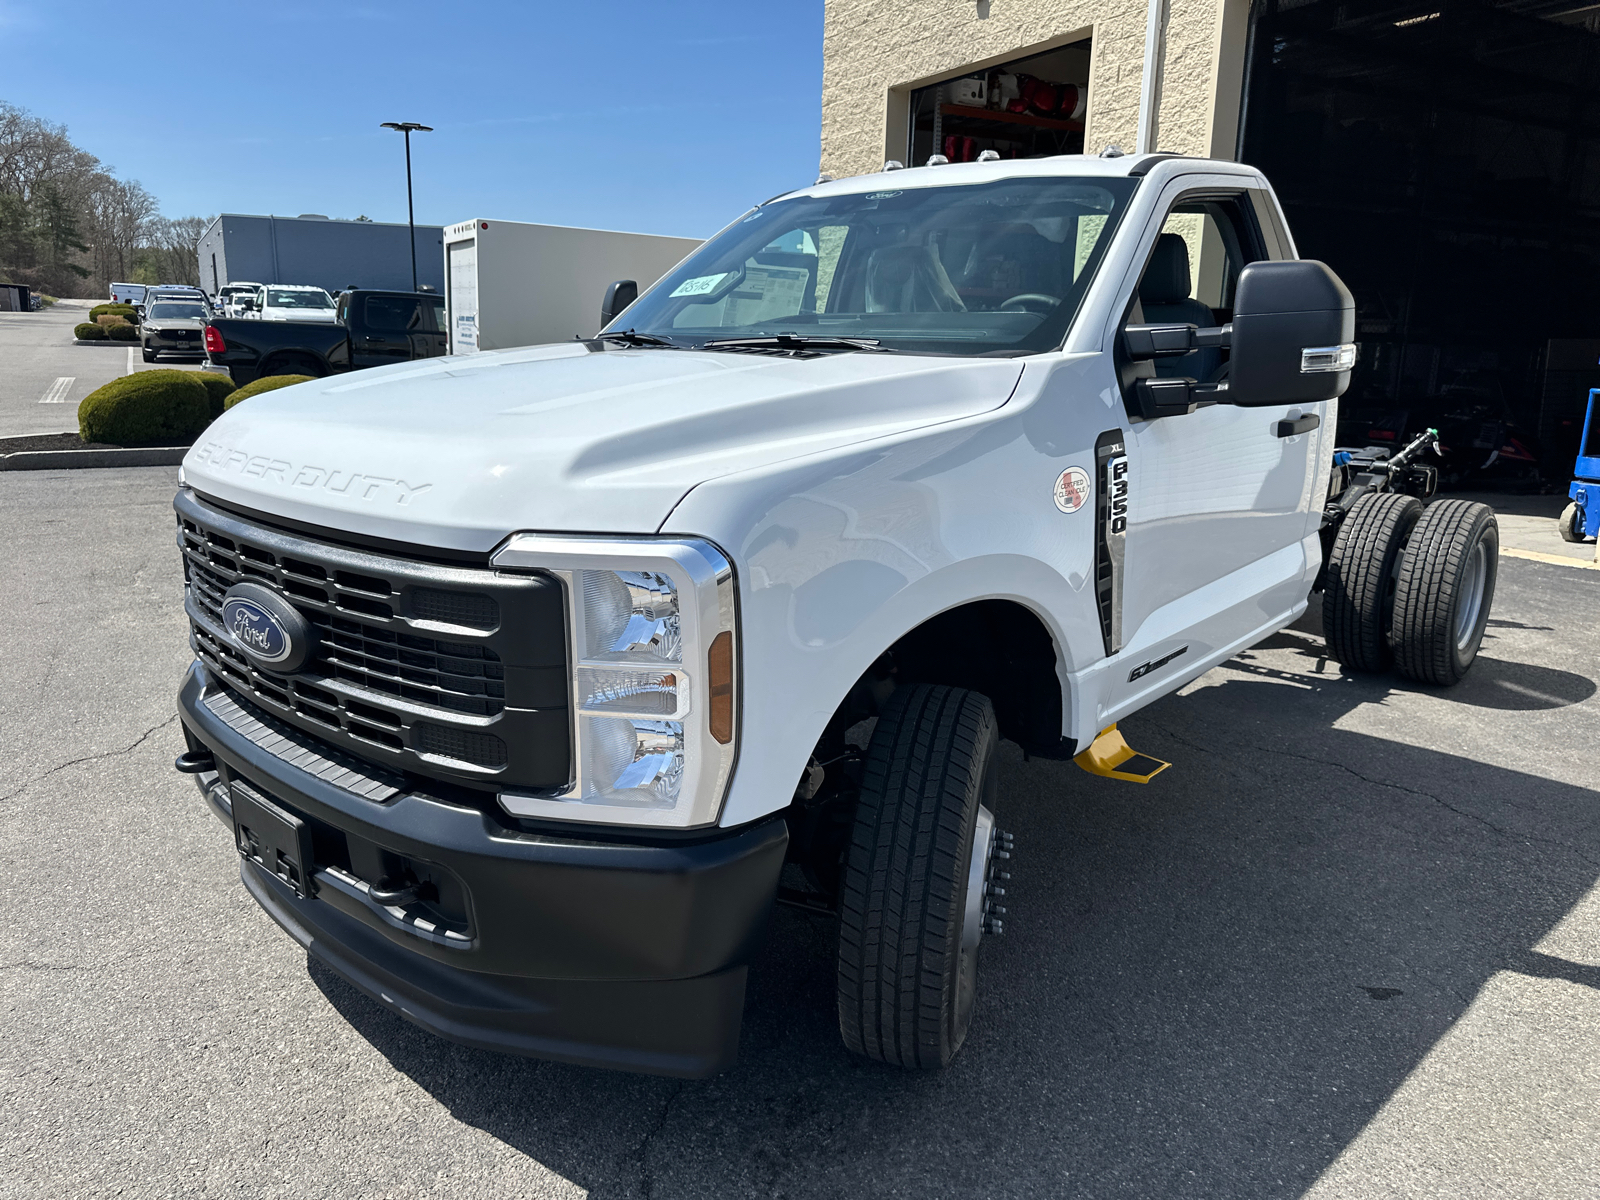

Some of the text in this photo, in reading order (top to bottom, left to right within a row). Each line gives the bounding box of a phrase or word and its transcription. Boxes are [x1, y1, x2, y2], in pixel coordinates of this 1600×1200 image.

[1111, 444, 1123, 454] XL
[194, 442, 433, 506] SUPER DUTY
[1061, 479, 1084, 490] CERTIFIED
[1058, 489, 1075, 498] CLEAN
[233, 607, 271, 650] Ford
